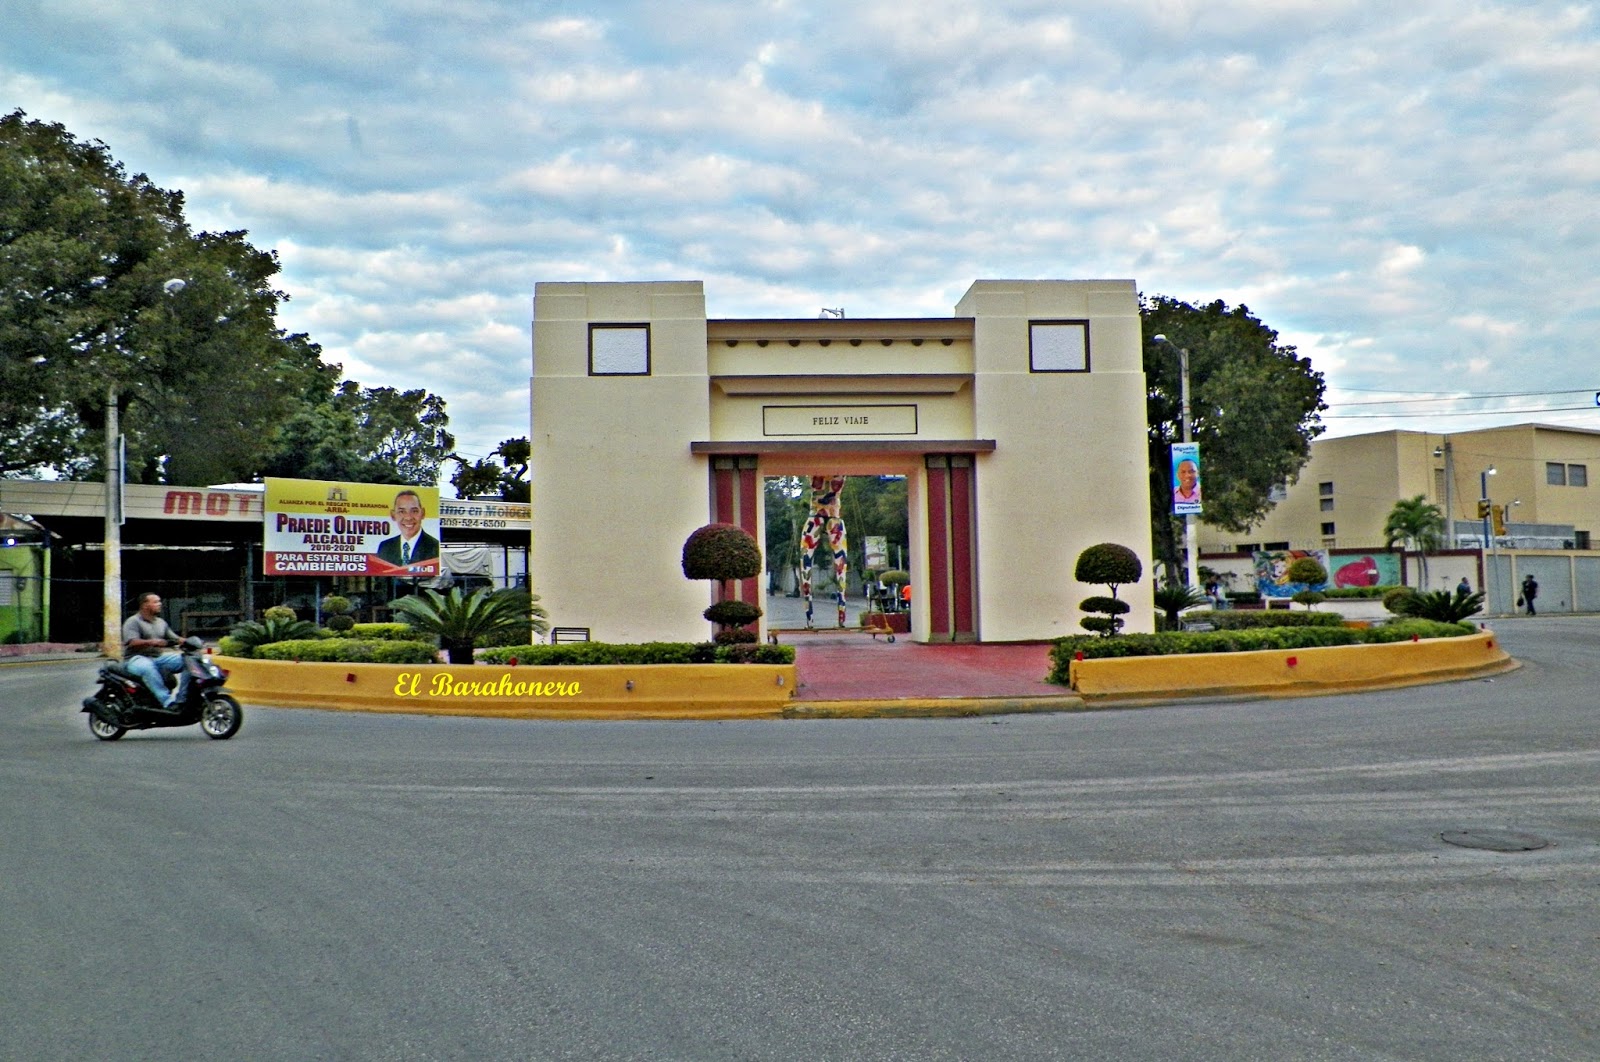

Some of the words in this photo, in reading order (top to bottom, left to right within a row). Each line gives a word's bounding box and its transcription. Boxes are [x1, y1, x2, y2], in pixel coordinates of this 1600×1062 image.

[812, 416, 839, 425] FELIZ
[844, 416, 869, 425] VIAJE
[163, 491, 264, 516] MOT
[468, 506, 482, 517] en
[303, 534, 364, 545] ALCALDE
[310, 544, 355, 552] 2016-2020
[275, 553, 303, 562] PARA
[306, 554, 340, 562] ESTAR
[343, 554, 367, 563] BIEN
[275, 561, 367, 571] CAMBIEMOS
